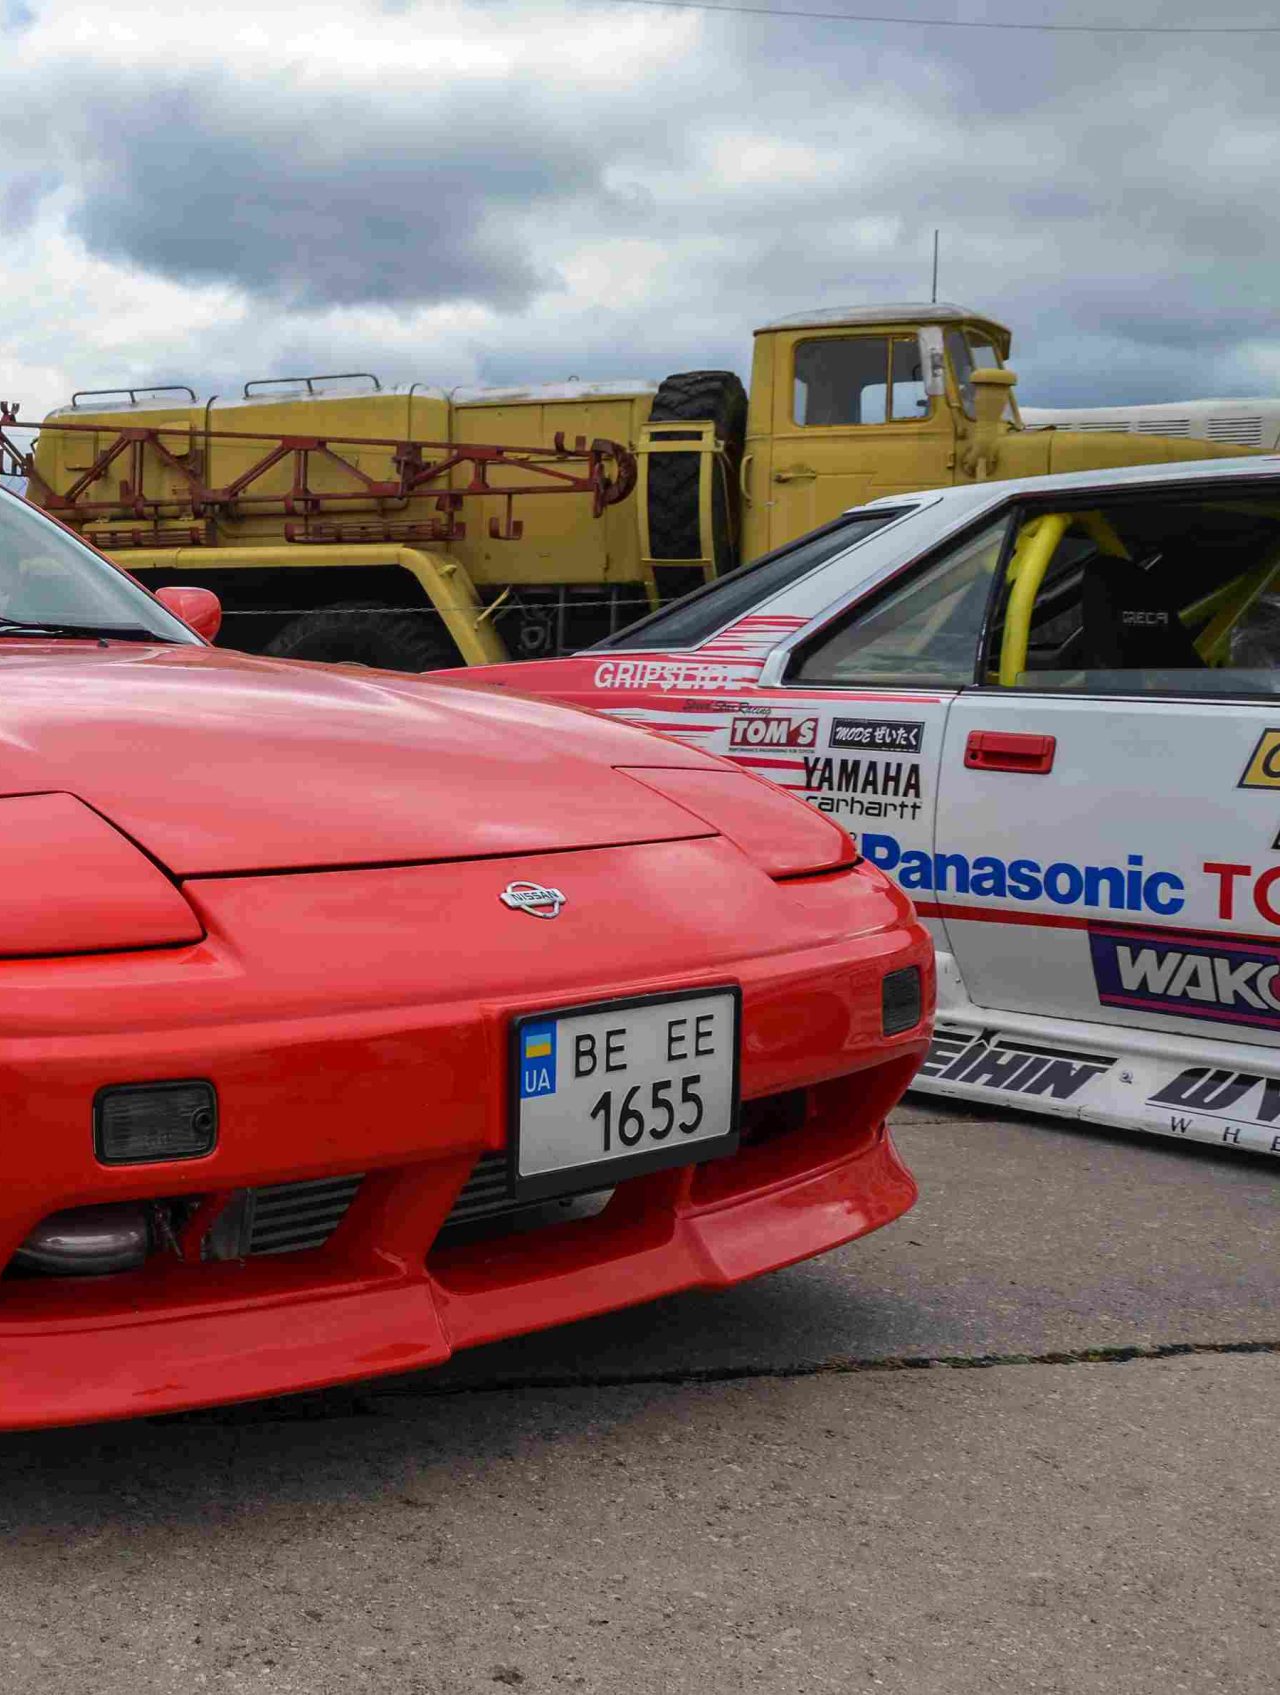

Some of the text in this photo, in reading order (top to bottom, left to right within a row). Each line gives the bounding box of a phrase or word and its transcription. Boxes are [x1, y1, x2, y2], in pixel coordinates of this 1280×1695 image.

[836, 727, 873, 743] MODE
[803, 756, 921, 798] YAMAHA
[862, 833, 1185, 915] Panasonic
[512, 890, 560, 902] NISSAN
[575, 1014, 715, 1078] BE EE
[525, 1068, 551, 1093] UA
[590, 1074, 704, 1151] 1655
